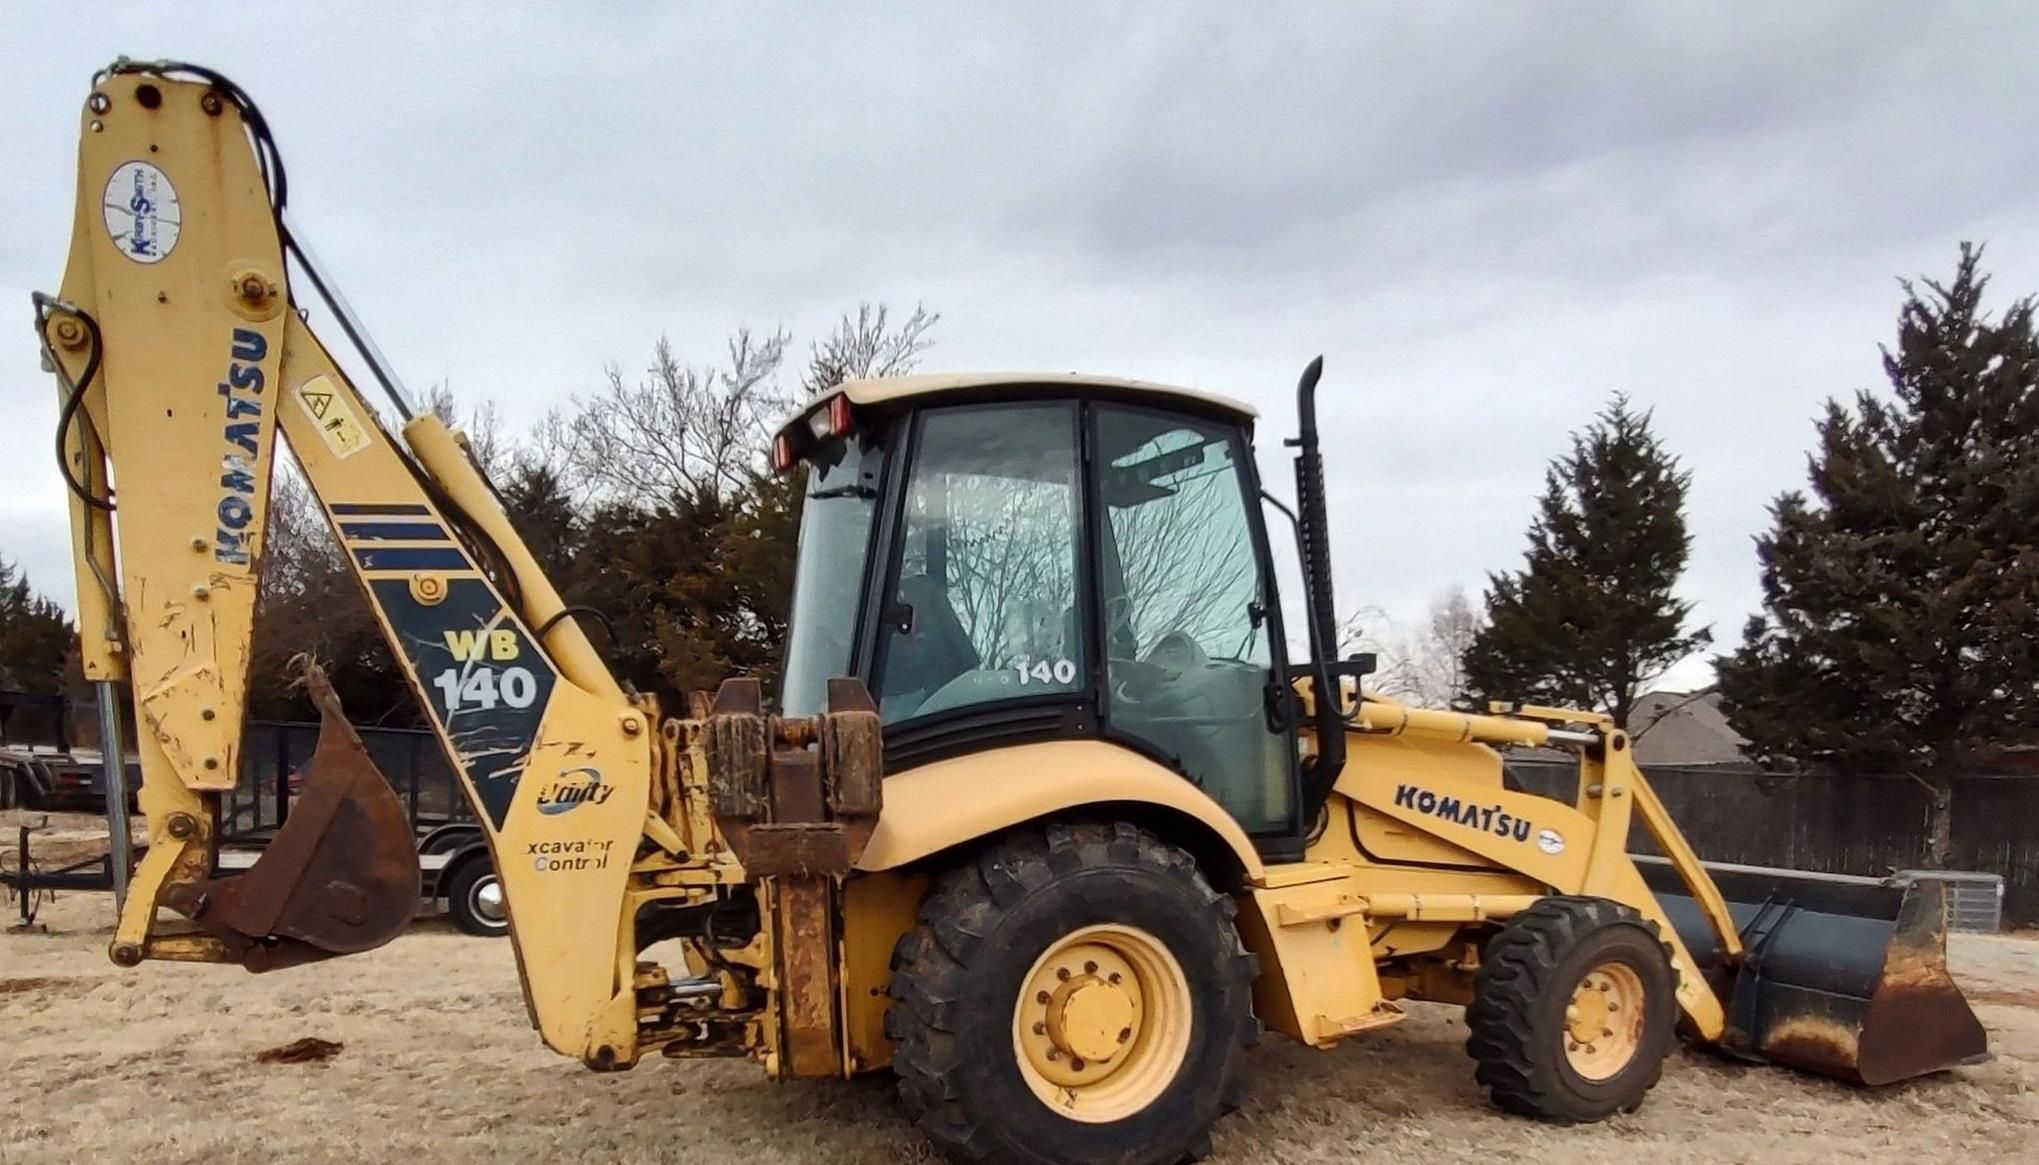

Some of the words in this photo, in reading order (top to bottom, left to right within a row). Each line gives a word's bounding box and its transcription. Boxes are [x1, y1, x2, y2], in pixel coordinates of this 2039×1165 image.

[215, 327, 268, 565] KOMATSU
[443, 629, 519, 662] WB
[433, 666, 537, 710] 140
[1015, 657, 1076, 686] 140
[1394, 783, 1532, 843] KOMATSU
[526, 839, 614, 855] xcavar
